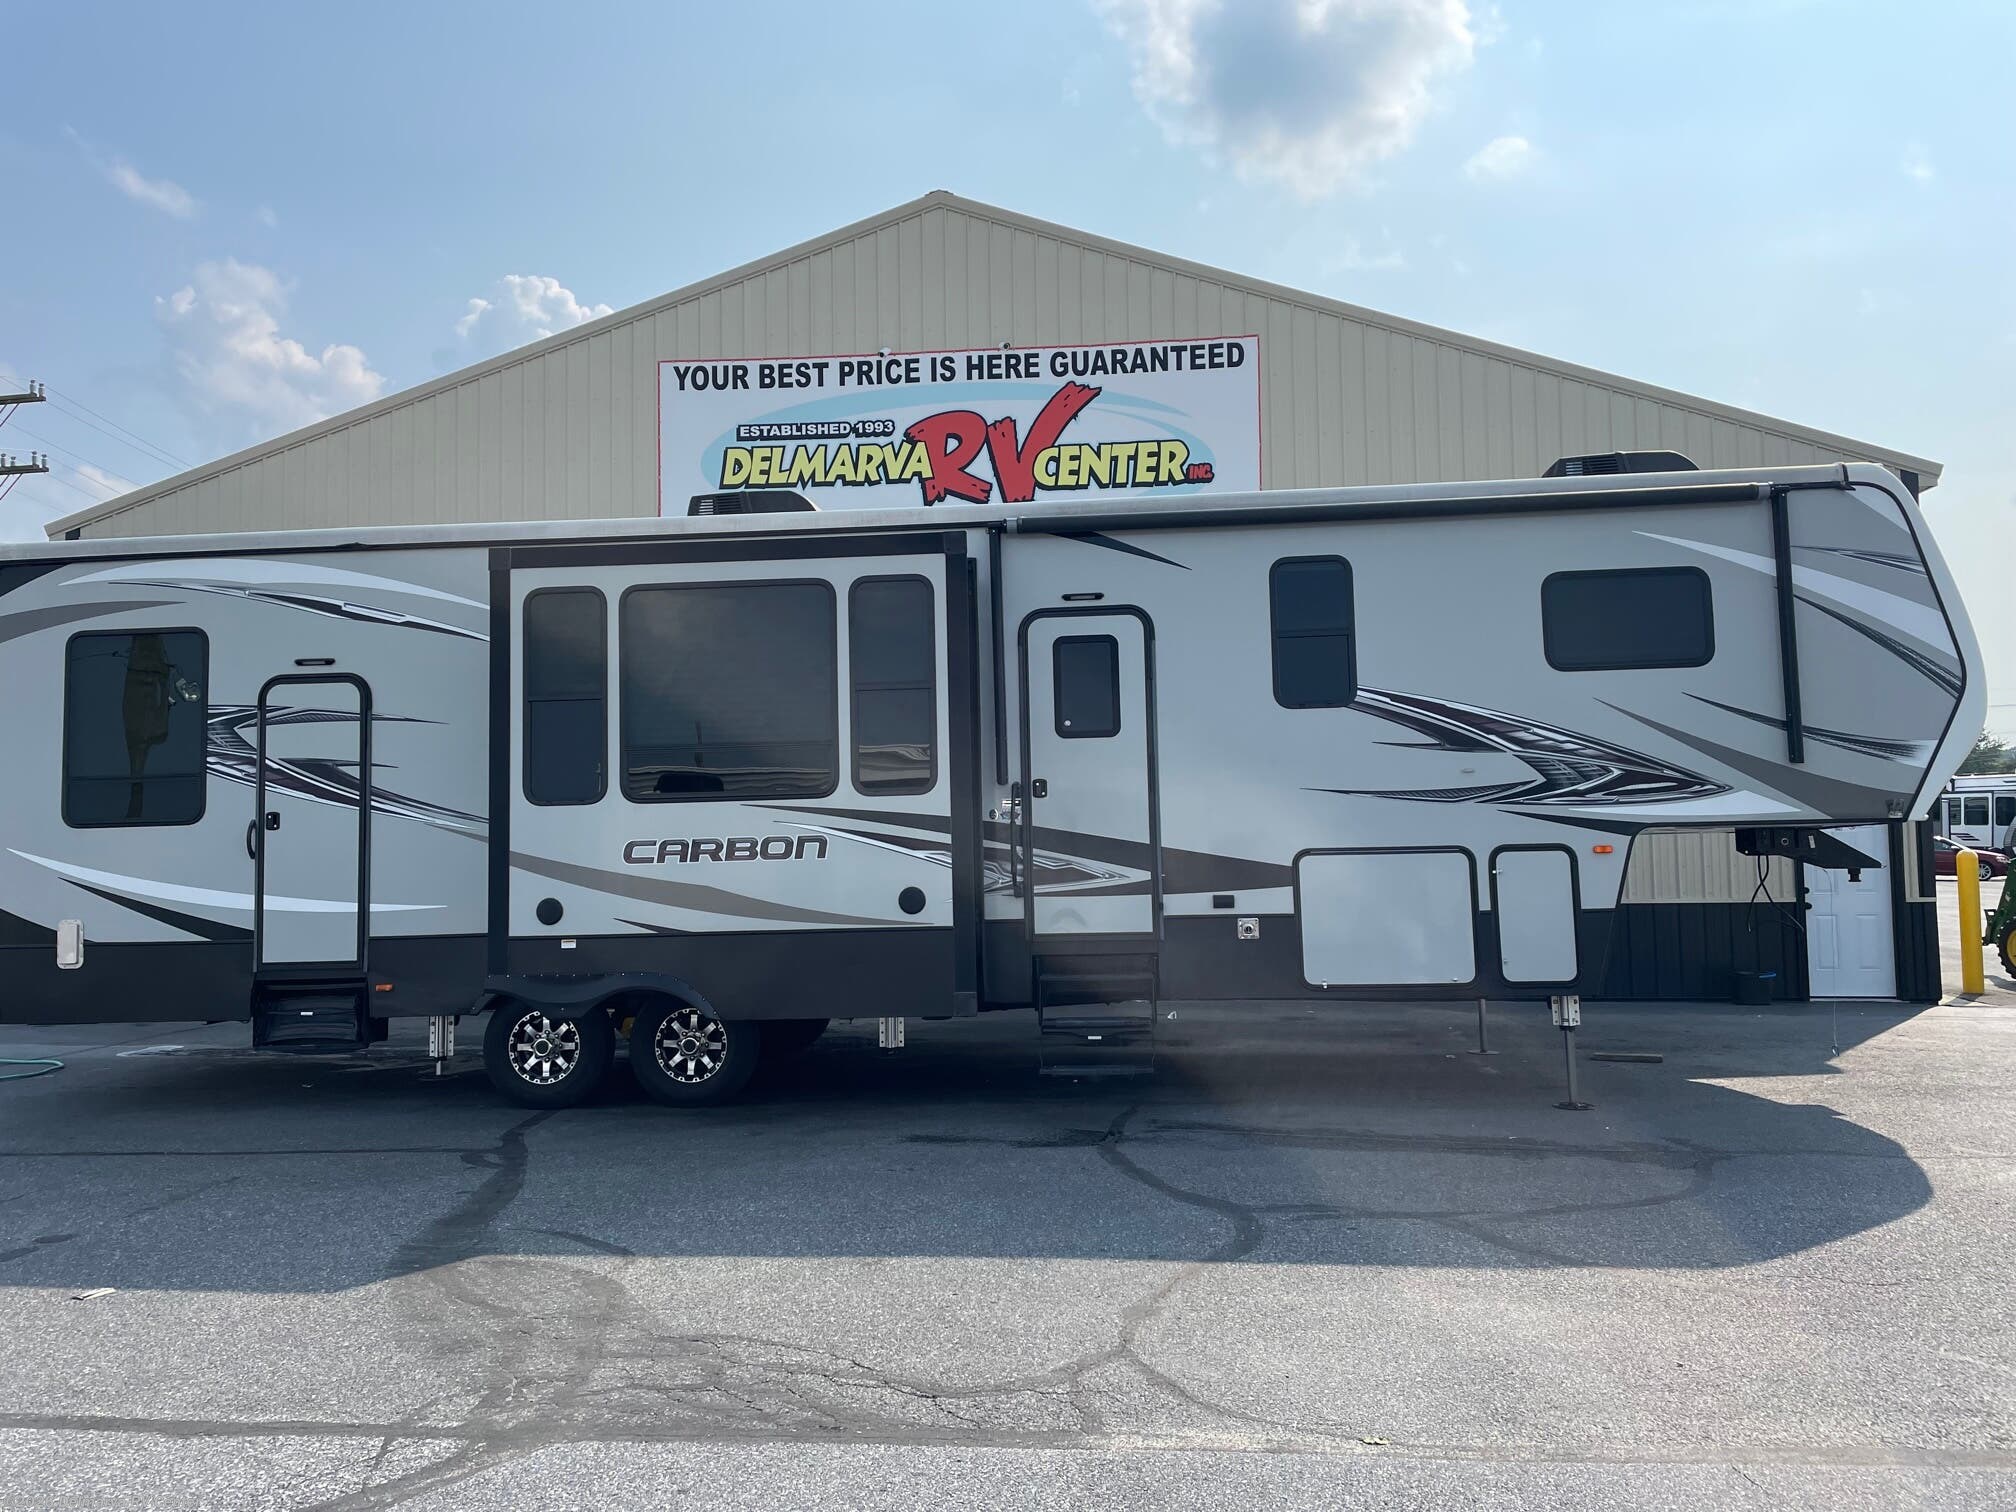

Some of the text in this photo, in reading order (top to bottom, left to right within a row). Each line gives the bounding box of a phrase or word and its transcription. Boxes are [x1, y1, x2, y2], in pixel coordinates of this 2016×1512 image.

[673, 342, 1245, 391] YOUR BEST PRICE IS HERE GUARANTEED
[721, 440, 934, 486] DELMARVA
[904, 381, 1102, 505] RV
[1032, 439, 1191, 490] CENTER
[739, 421, 894, 437] ESTABLISHED 1993
[623, 835, 829, 865] CARBON
